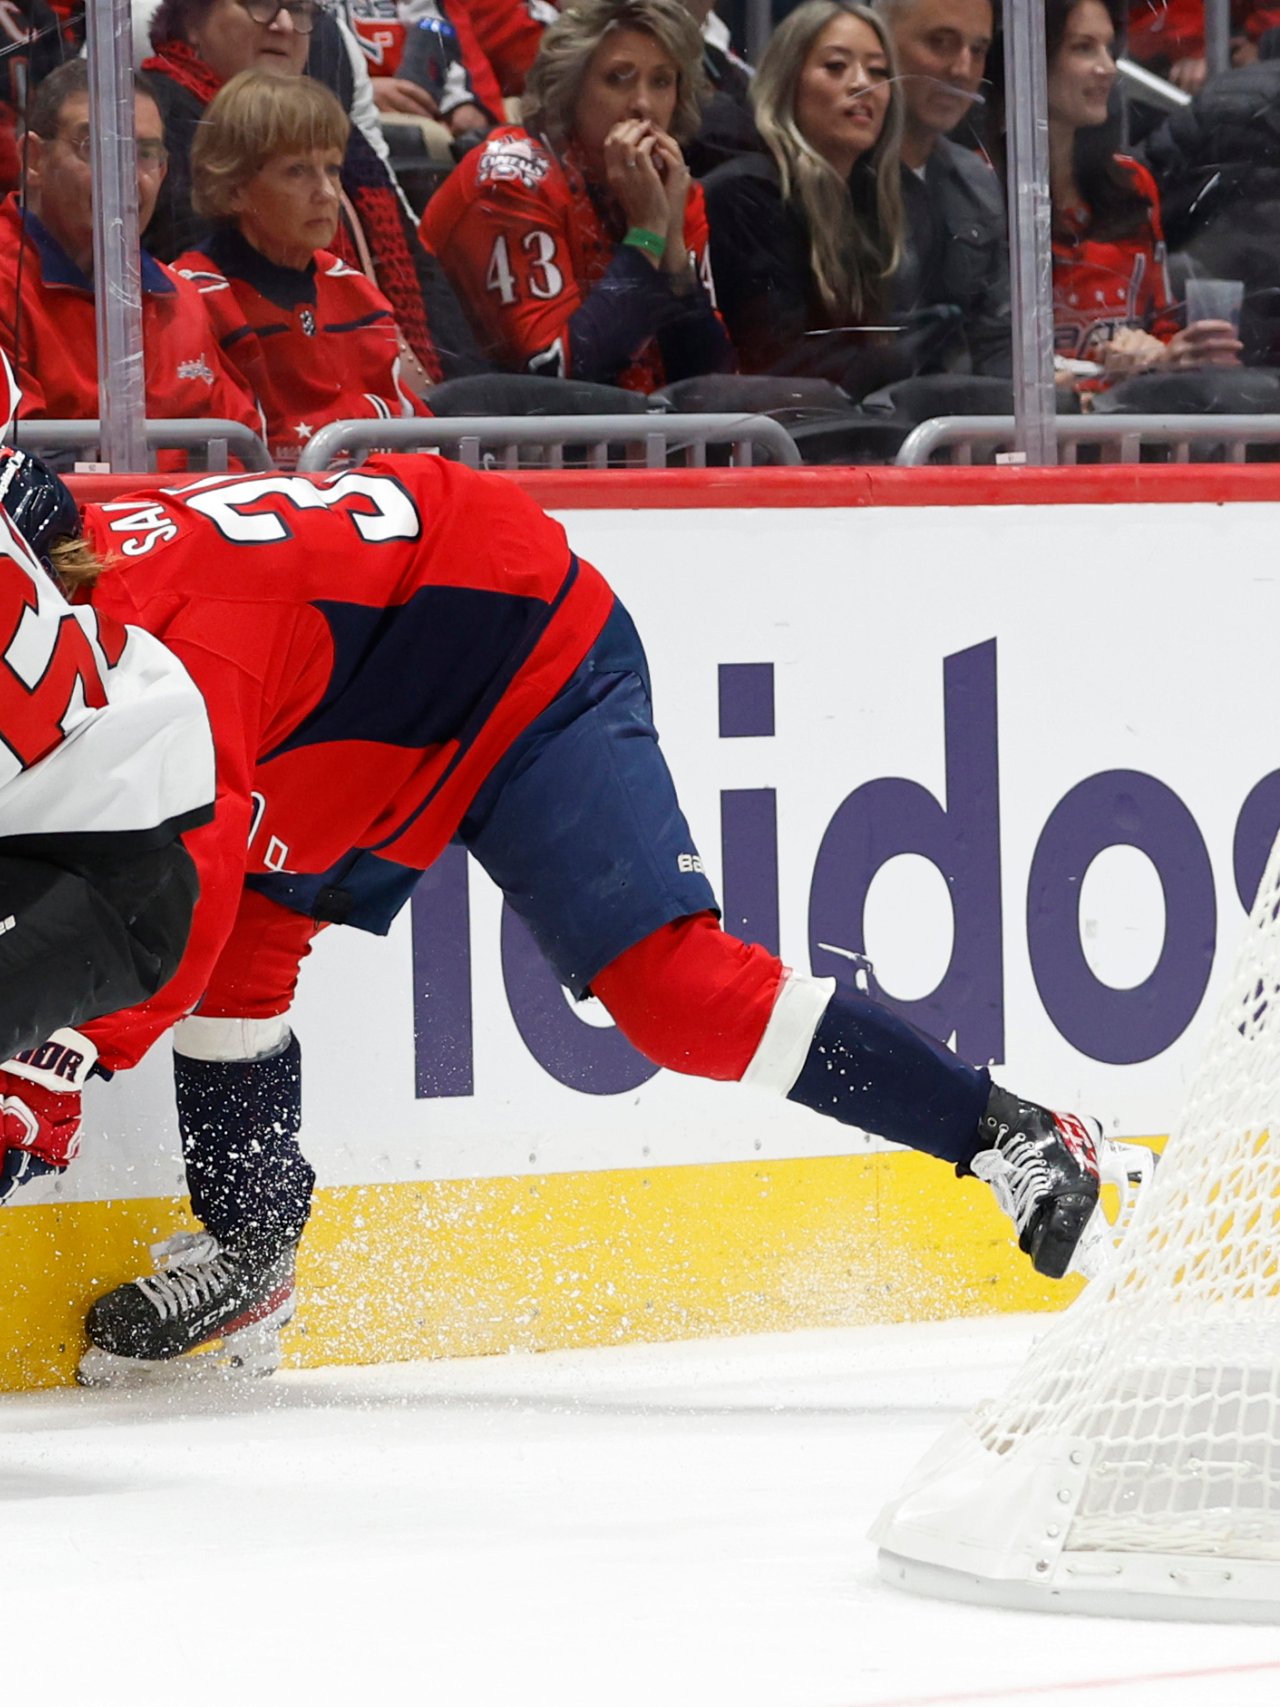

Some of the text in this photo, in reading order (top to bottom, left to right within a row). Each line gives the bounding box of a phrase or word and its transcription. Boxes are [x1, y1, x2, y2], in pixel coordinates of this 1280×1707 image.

[487, 230, 563, 303] 43
[101, 500, 179, 556] SA
[677, 853, 705, 873] BA
